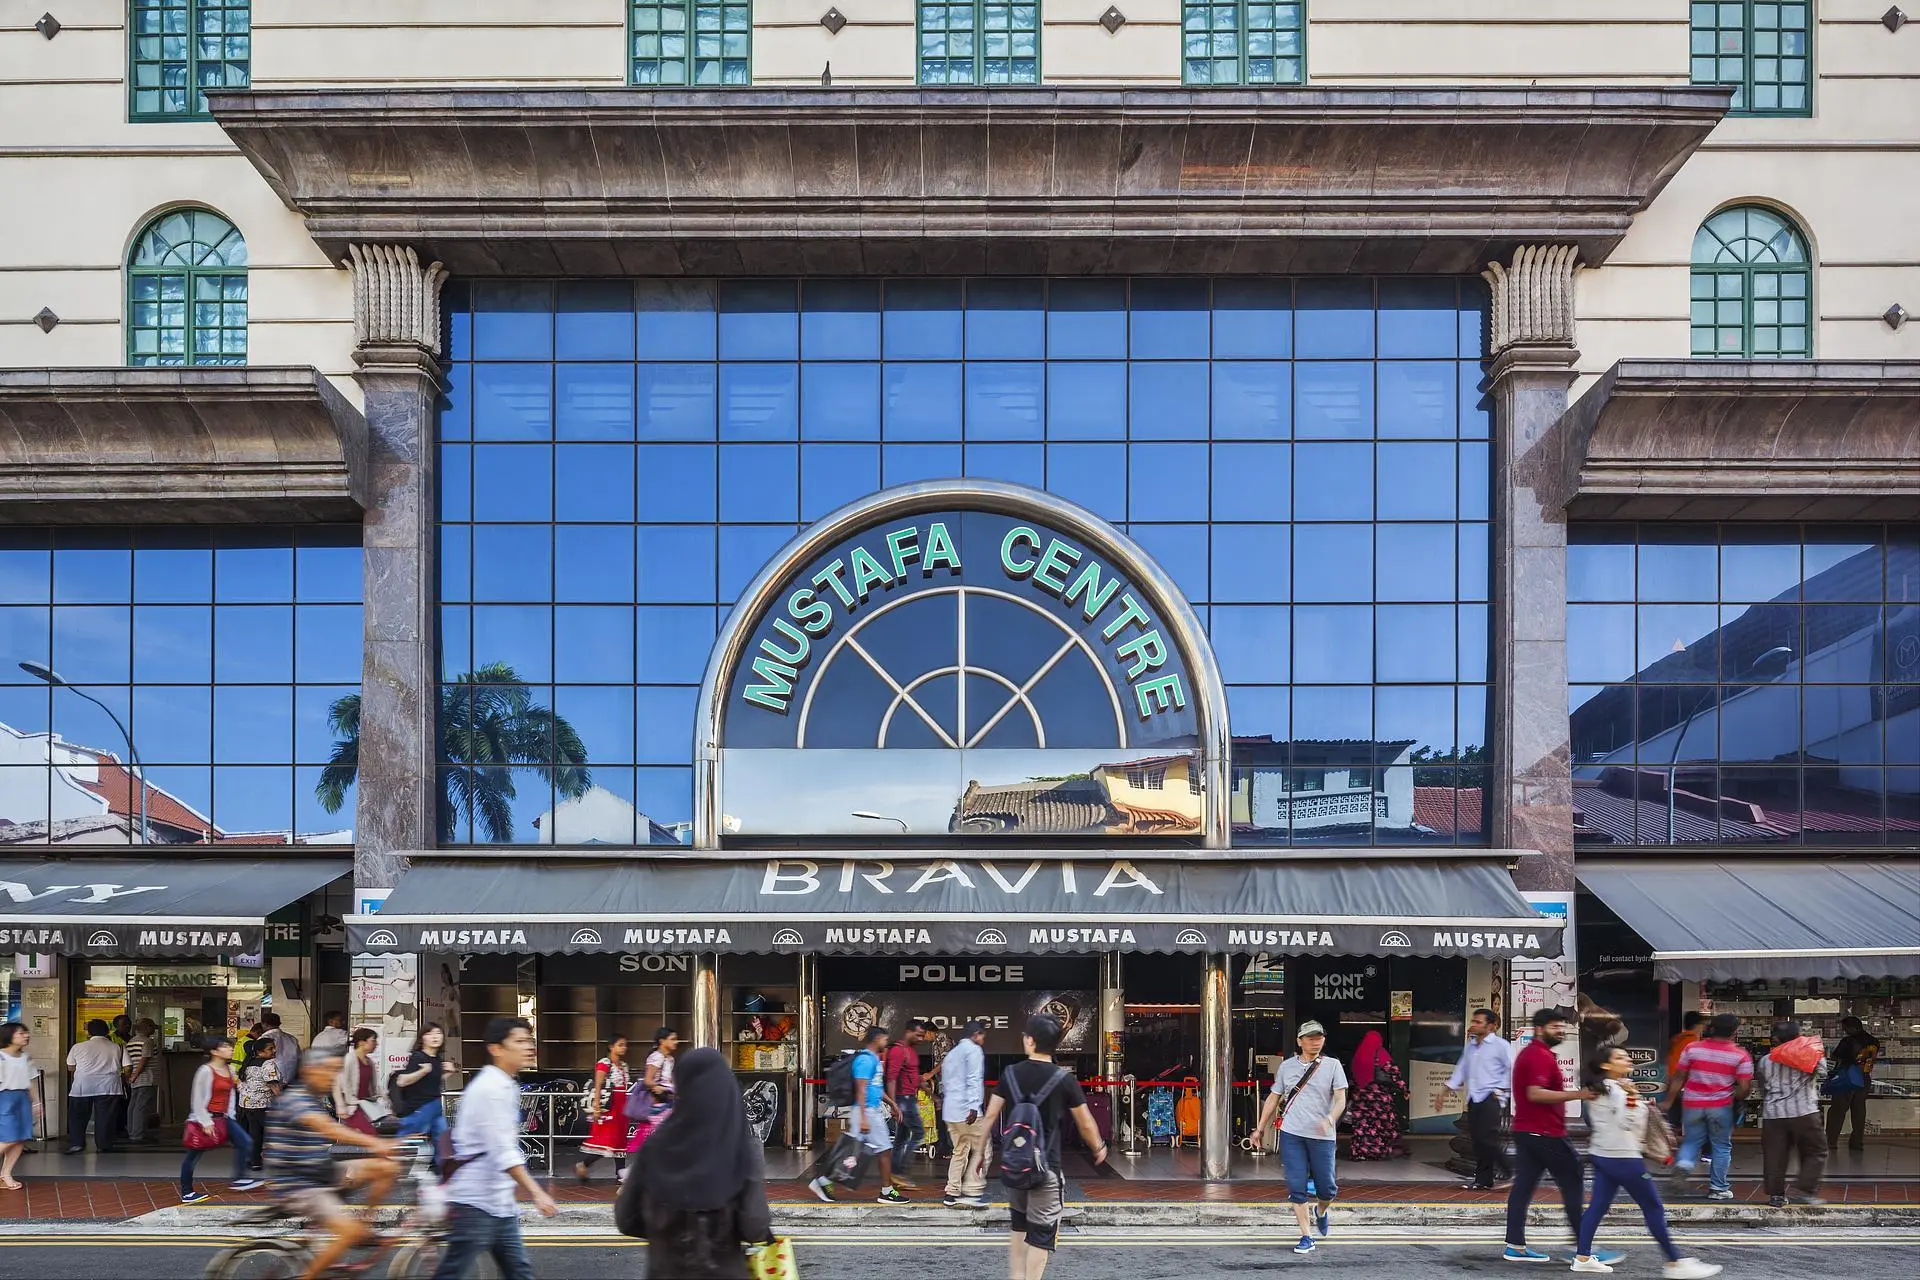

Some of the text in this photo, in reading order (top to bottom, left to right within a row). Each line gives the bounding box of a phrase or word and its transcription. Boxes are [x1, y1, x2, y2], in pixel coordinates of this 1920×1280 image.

[742, 522, 1186, 719] MUSTAFA CENTRE
[759, 859, 1164, 897] BRAVIA
[0, 929, 64, 944] STAFA
[139, 930, 243, 946] MUSTAFA
[419, 929, 527, 945] MUSTAFA
[623, 928, 732, 944] MUSTAFA
[825, 928, 932, 944] MUSTAFA
[1028, 928, 1137, 944] MUSTAFA
[1227, 929, 1334, 946] MUSTAFA
[1433, 932, 1541, 949] MUSTAFA
[240, 957, 257, 965] EXIT
[619, 954, 692, 972] SON
[125, 973, 217, 986] ENTRANCE
[900, 965, 1024, 982] POLICE
[1314, 973, 1364, 986] MONT
[1314, 987, 1364, 1000] BLANC
[1557, 1058, 1574, 1066] ood
